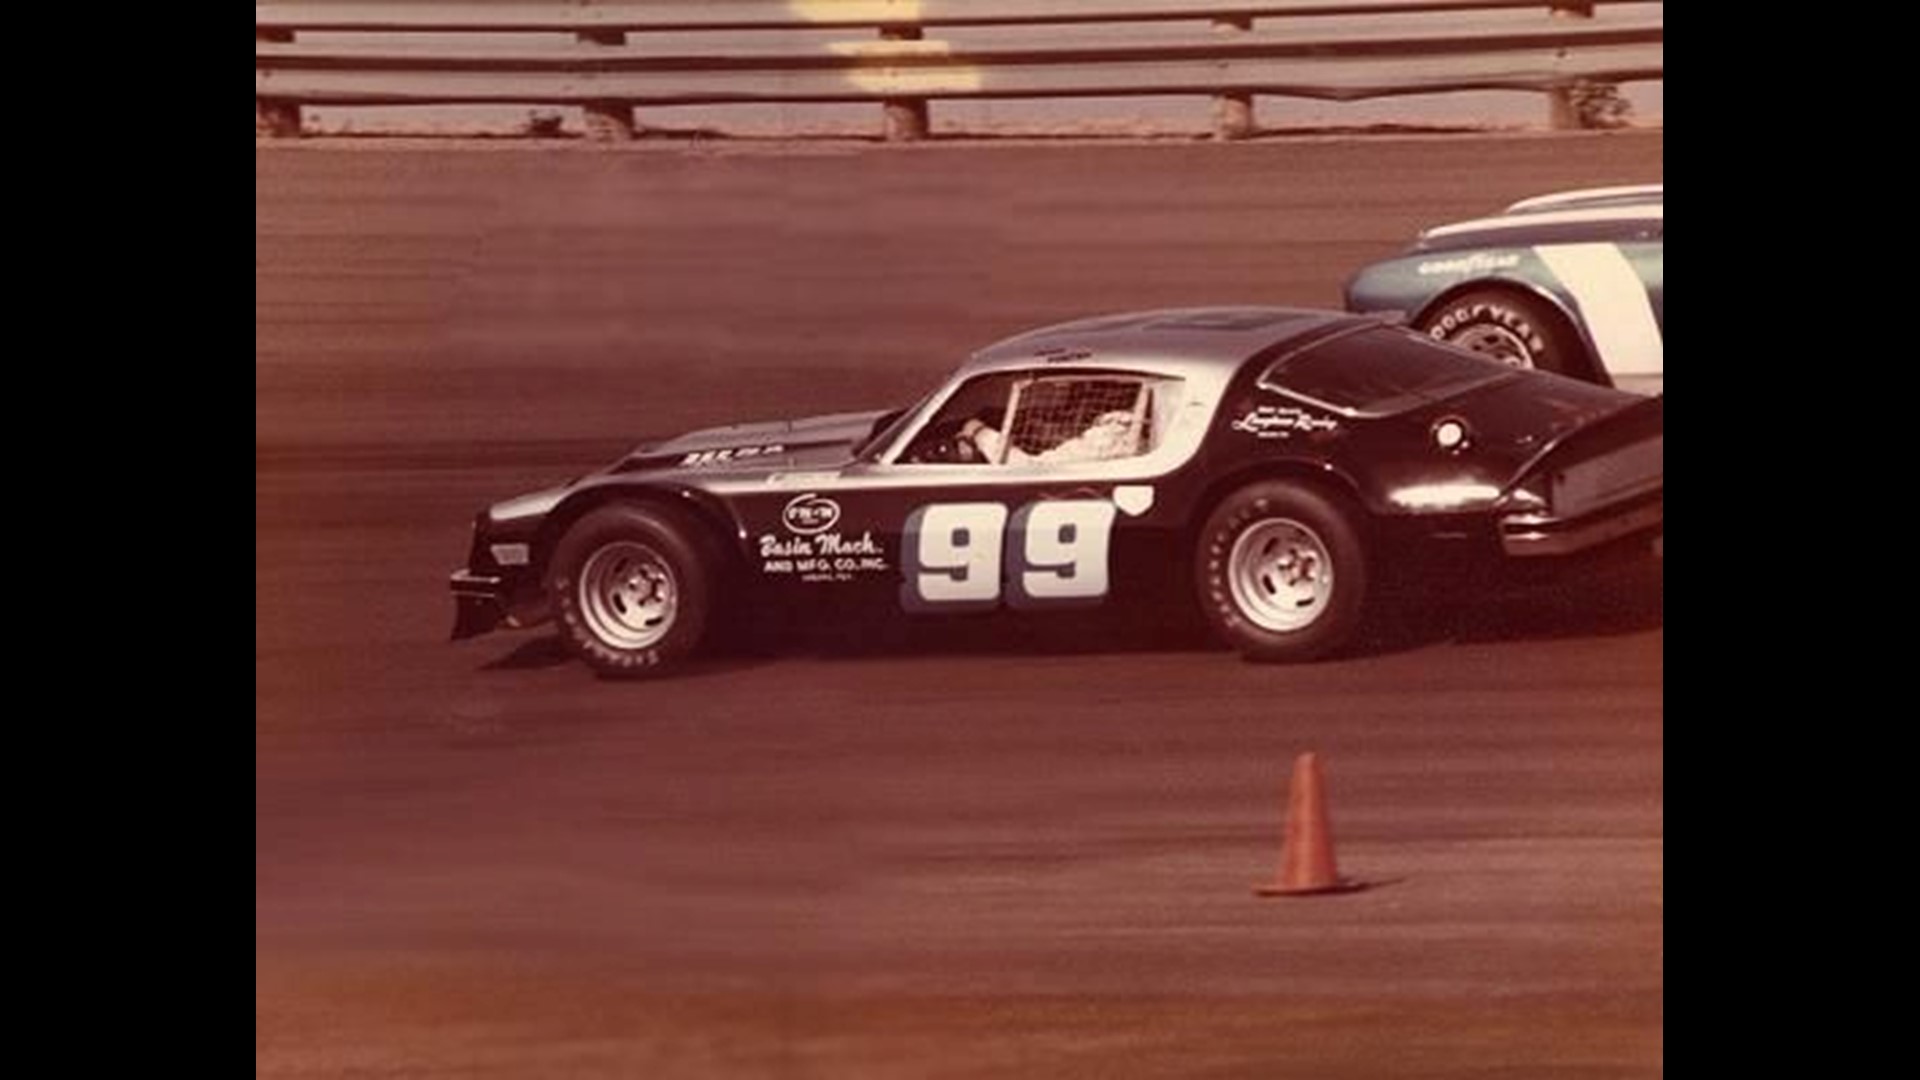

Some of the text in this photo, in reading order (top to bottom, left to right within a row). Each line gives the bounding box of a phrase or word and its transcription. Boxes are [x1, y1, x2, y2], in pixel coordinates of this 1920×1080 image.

[759, 533, 813, 557] Basin
[916, 499, 1117, 602] 99
[763, 560, 794, 573] AND
